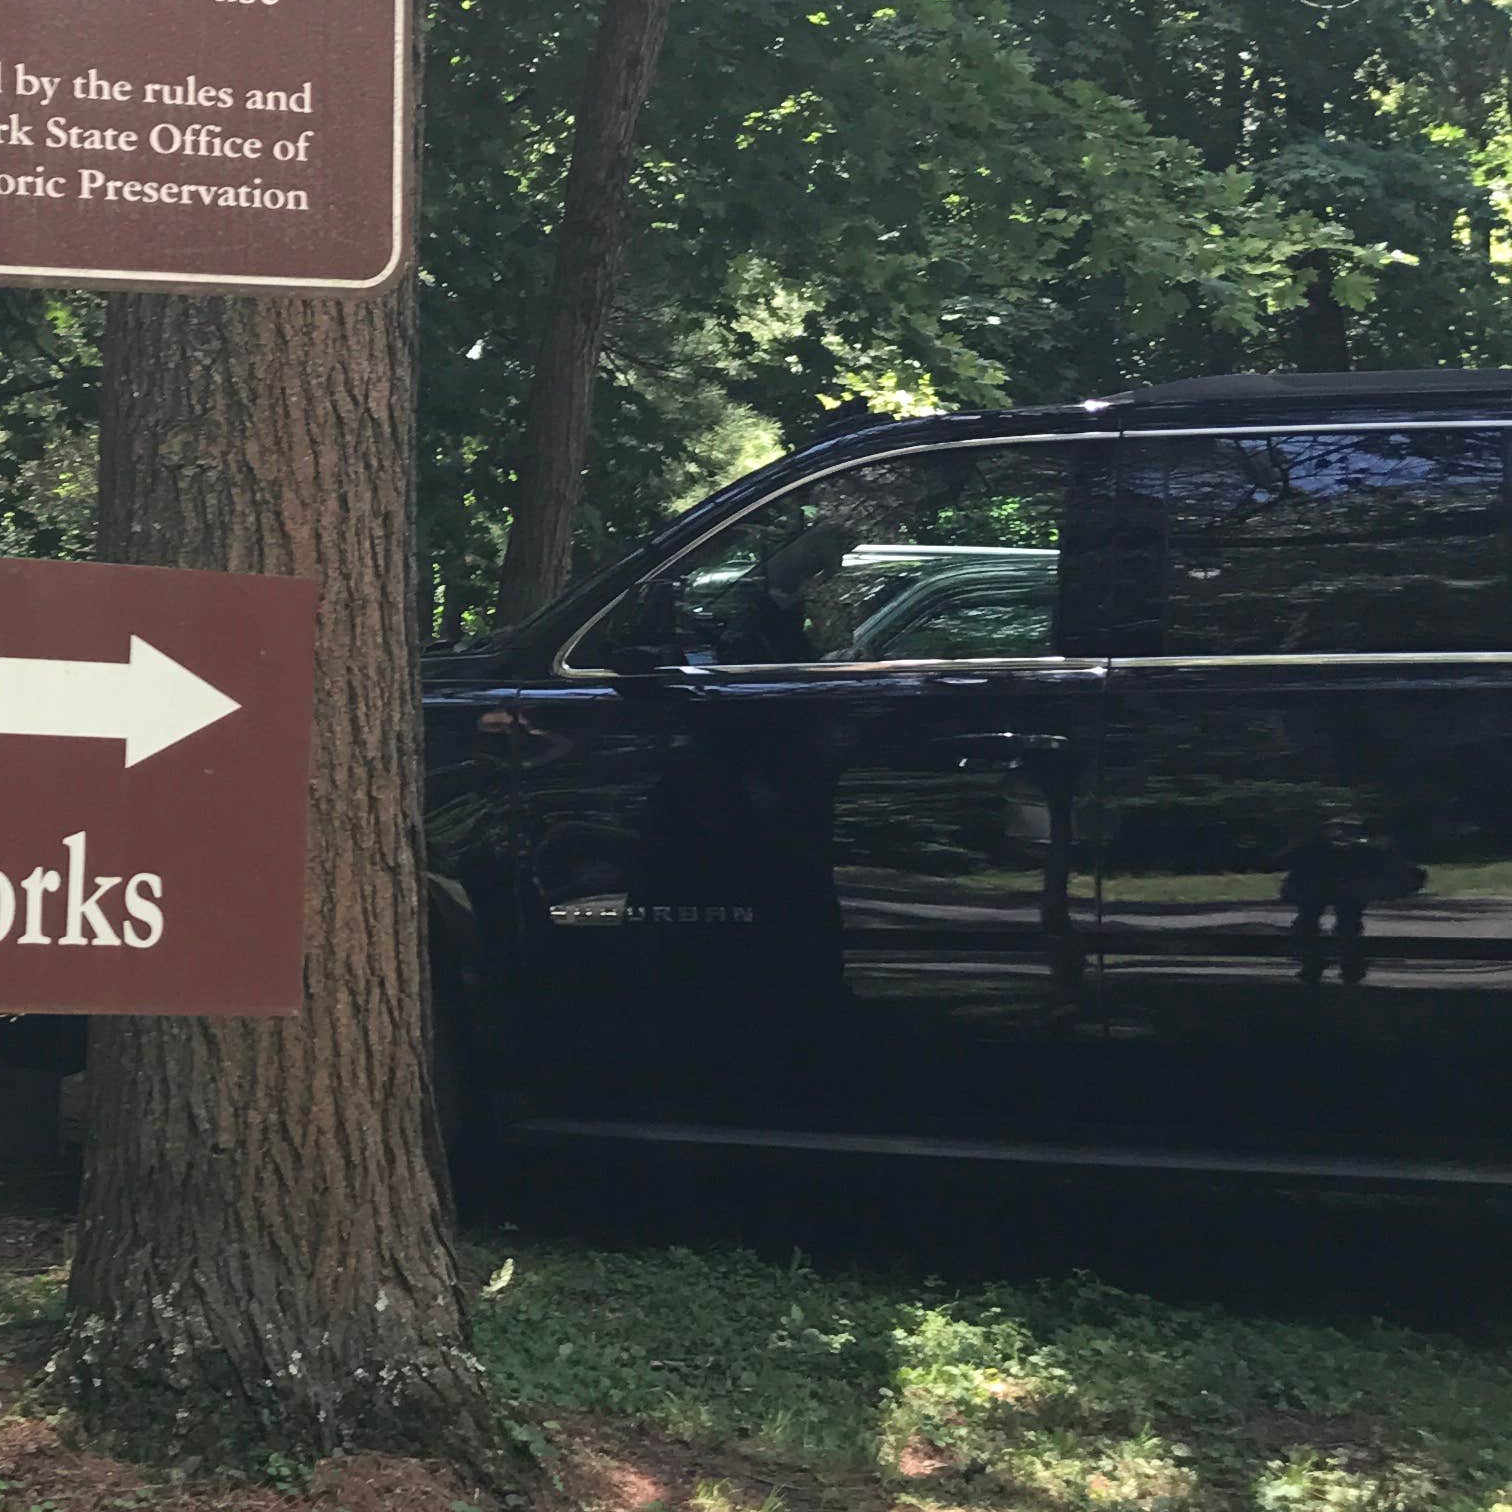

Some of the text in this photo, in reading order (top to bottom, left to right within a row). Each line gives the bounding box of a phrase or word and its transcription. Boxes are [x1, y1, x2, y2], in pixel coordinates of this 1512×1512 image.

[15, 63, 61, 105] by
[73, 69, 133, 101] the
[143, 75, 233, 108] rules
[246, 82, 313, 113] and
[46, 117, 138, 151] State
[149, 124, 262, 158] Office
[273, 131, 314, 161] of
[78, 169, 309, 210] Preservation
